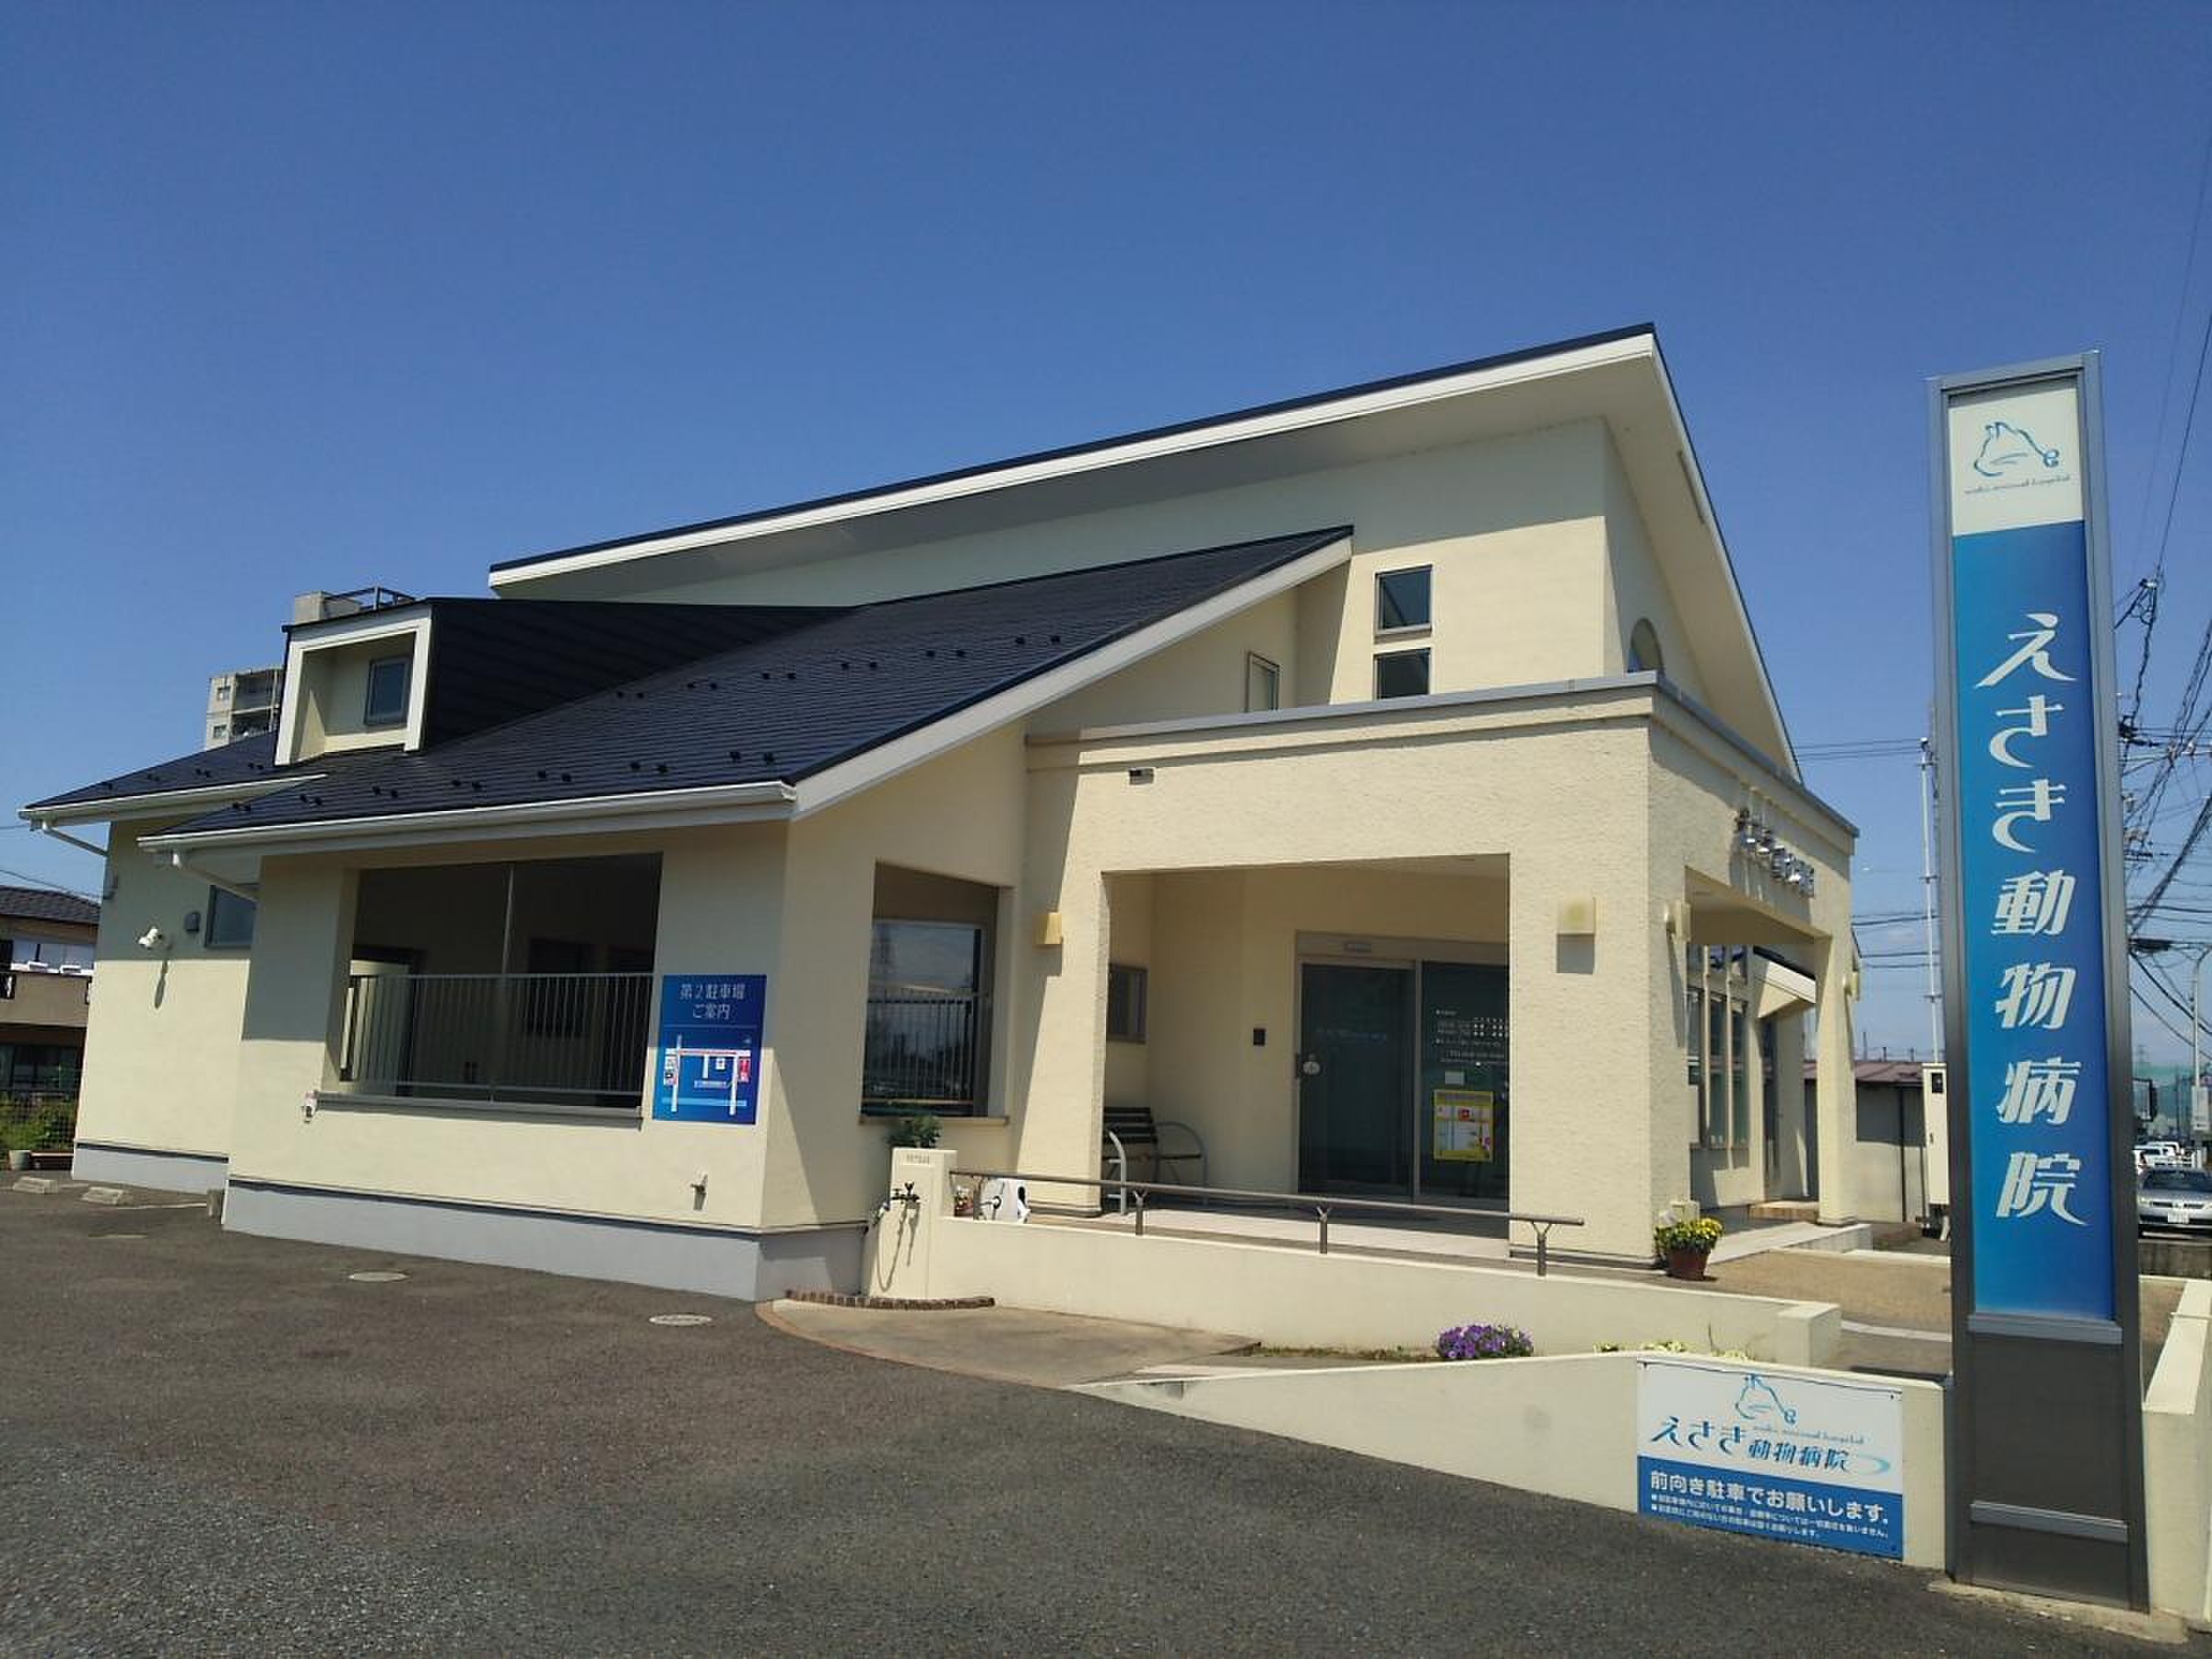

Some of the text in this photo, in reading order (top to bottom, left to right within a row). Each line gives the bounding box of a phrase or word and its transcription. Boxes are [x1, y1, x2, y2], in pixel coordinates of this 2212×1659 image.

[1974, 614, 2088, 1226] えさき動物病院
[1650, 1416, 1851, 1472] えさき動物病院
